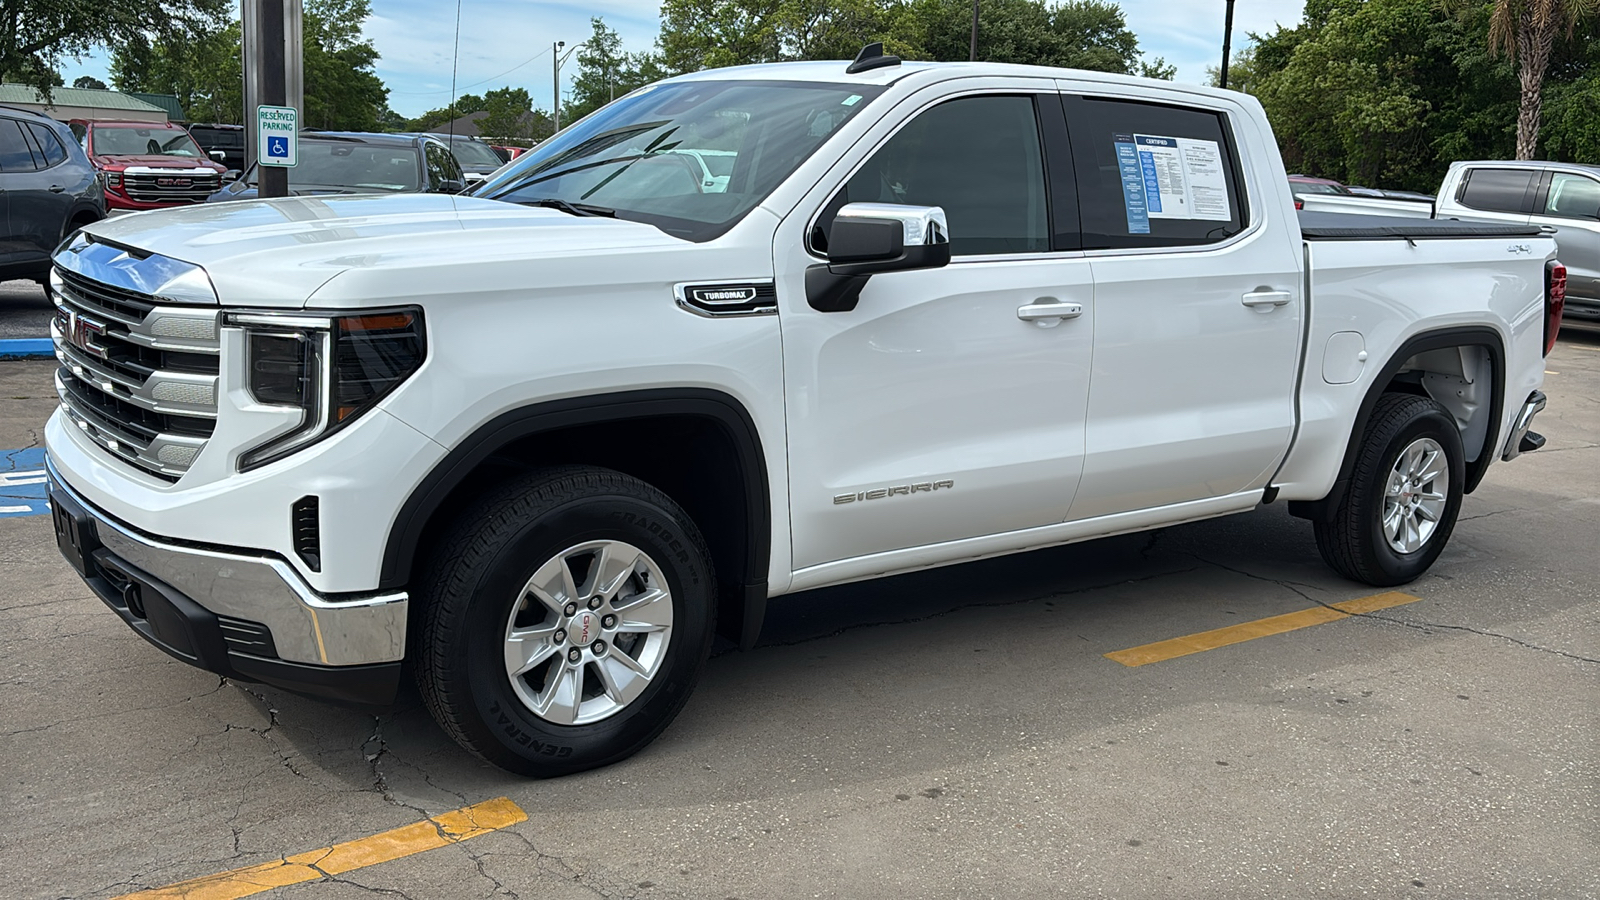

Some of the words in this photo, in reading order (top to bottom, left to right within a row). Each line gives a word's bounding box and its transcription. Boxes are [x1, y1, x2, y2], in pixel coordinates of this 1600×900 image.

[261, 112, 295, 121] RESERVED
[263, 122, 293, 131] PARKING
[1145, 138, 1168, 146] CERTIFIED
[157, 178, 192, 186] GMC
[704, 291, 746, 300] TURBOMAX
[57, 305, 109, 360] GMC
[833, 478, 954, 505] SIERRA
[581, 615, 590, 643] GMC
[489, 700, 573, 757] GENERAL
